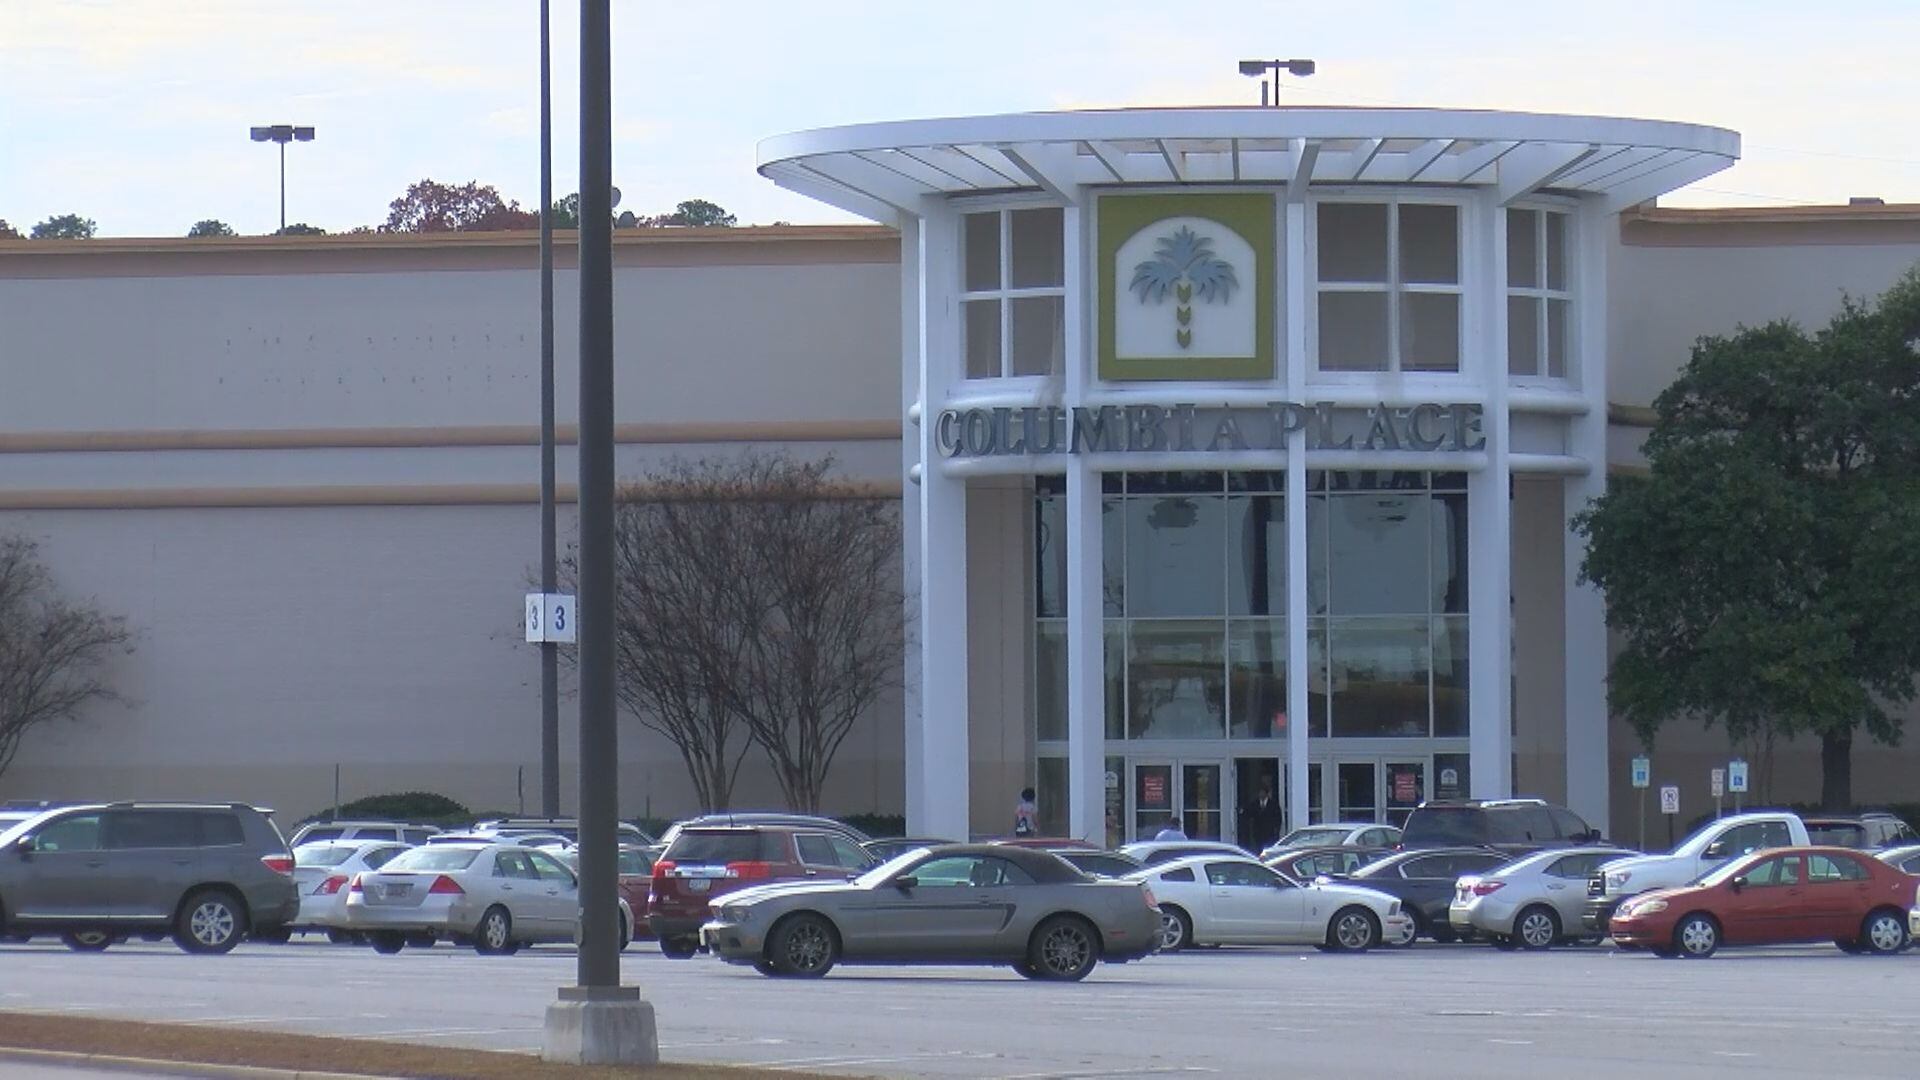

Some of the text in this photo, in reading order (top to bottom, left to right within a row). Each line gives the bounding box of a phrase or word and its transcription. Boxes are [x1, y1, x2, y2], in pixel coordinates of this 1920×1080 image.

[934, 401, 1487, 457] COLUMBIA PLACE
[531, 605, 539, 630] 3
[555, 605, 566, 630] 3
